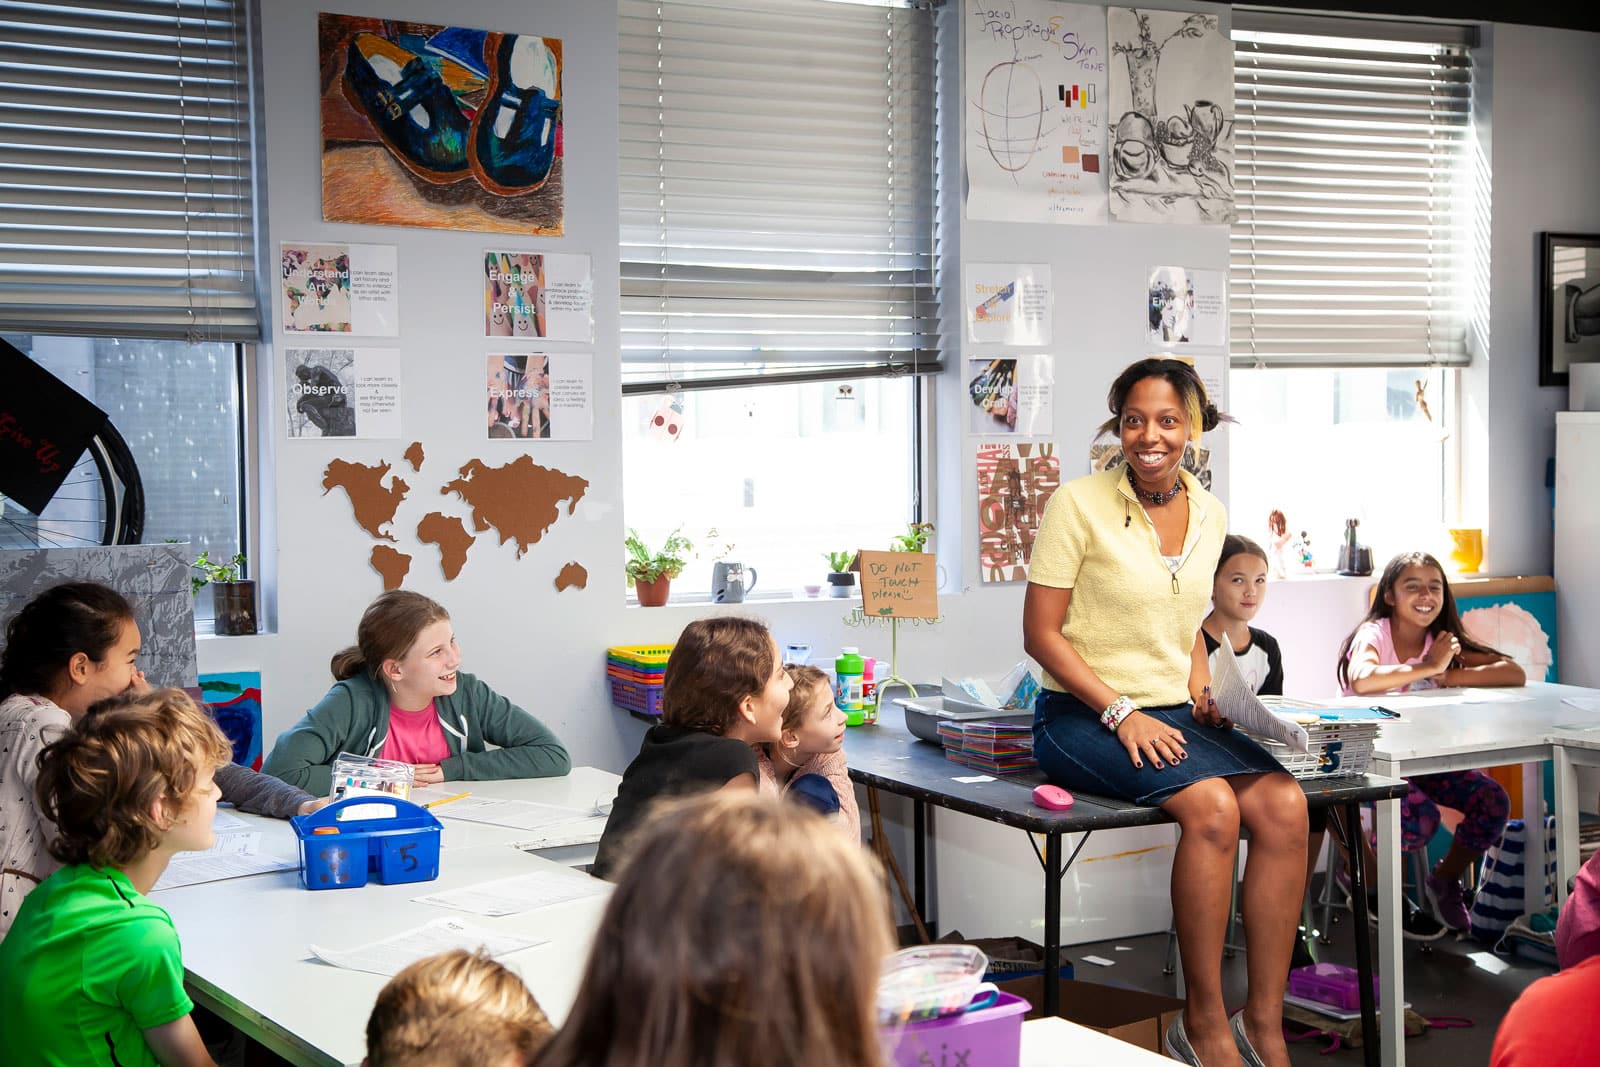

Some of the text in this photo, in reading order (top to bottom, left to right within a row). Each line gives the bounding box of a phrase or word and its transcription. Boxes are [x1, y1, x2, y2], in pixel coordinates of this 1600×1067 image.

[1063, 31, 1098, 60] Skin
[284, 268, 350, 279] Understand
[489, 270, 535, 284] Engage
[309, 282, 327, 292] Art
[493, 302, 536, 314] Persist
[292, 383, 348, 395] Observe
[490, 388, 539, 399] Express
[974, 384, 1014, 395] Develop
[869, 562, 888, 576] DO
[399, 842, 420, 873] 5
[918, 1043, 971, 1067] six
